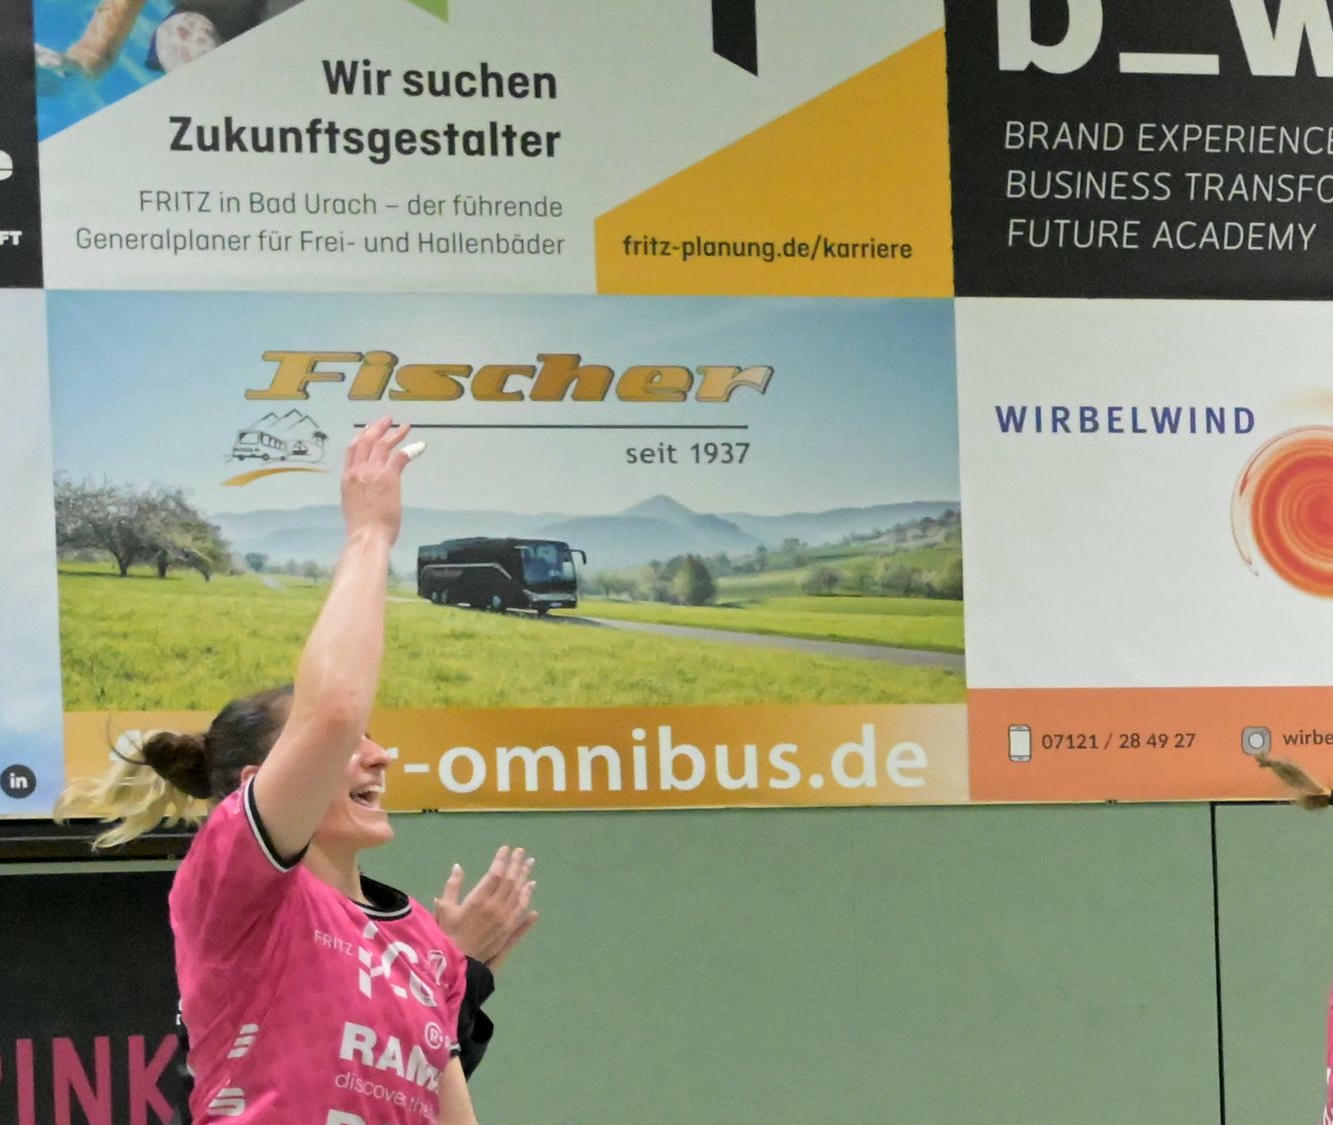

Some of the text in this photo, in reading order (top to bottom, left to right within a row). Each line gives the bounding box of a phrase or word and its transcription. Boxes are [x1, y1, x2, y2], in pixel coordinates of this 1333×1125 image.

[322, 59, 556, 99] Wir suchen
[170, 117, 561, 164] Zukunftsgestalter
[1005, 121, 1123, 150] BRAND
[1007, 170, 1171, 200] BUSINESS
[140, 190, 211, 212] FRITZ
[220, 192, 240, 213] in
[250, 192, 296, 214] Bad
[305, 193, 376, 215] Urach
[408, 194, 445, 216] der
[453, 195, 562, 217] führende
[77, 228, 565, 255] Generalplaner für Frei- und Hallenbäder
[623, 235, 912, 262] fritz-planung.de/karriere
[1009, 219, 1316, 250] FUTURE ACADEMY
[244, 350, 774, 403] Fischer
[995, 406, 1254, 434] WIRBELWIND
[626, 442, 750, 464] seit 1937
[1042, 734, 1098, 749] 07121
[1120, 733, 1140, 748] 28
[1146, 734, 1168, 748] 49
[1174, 733, 1195, 748] 27
